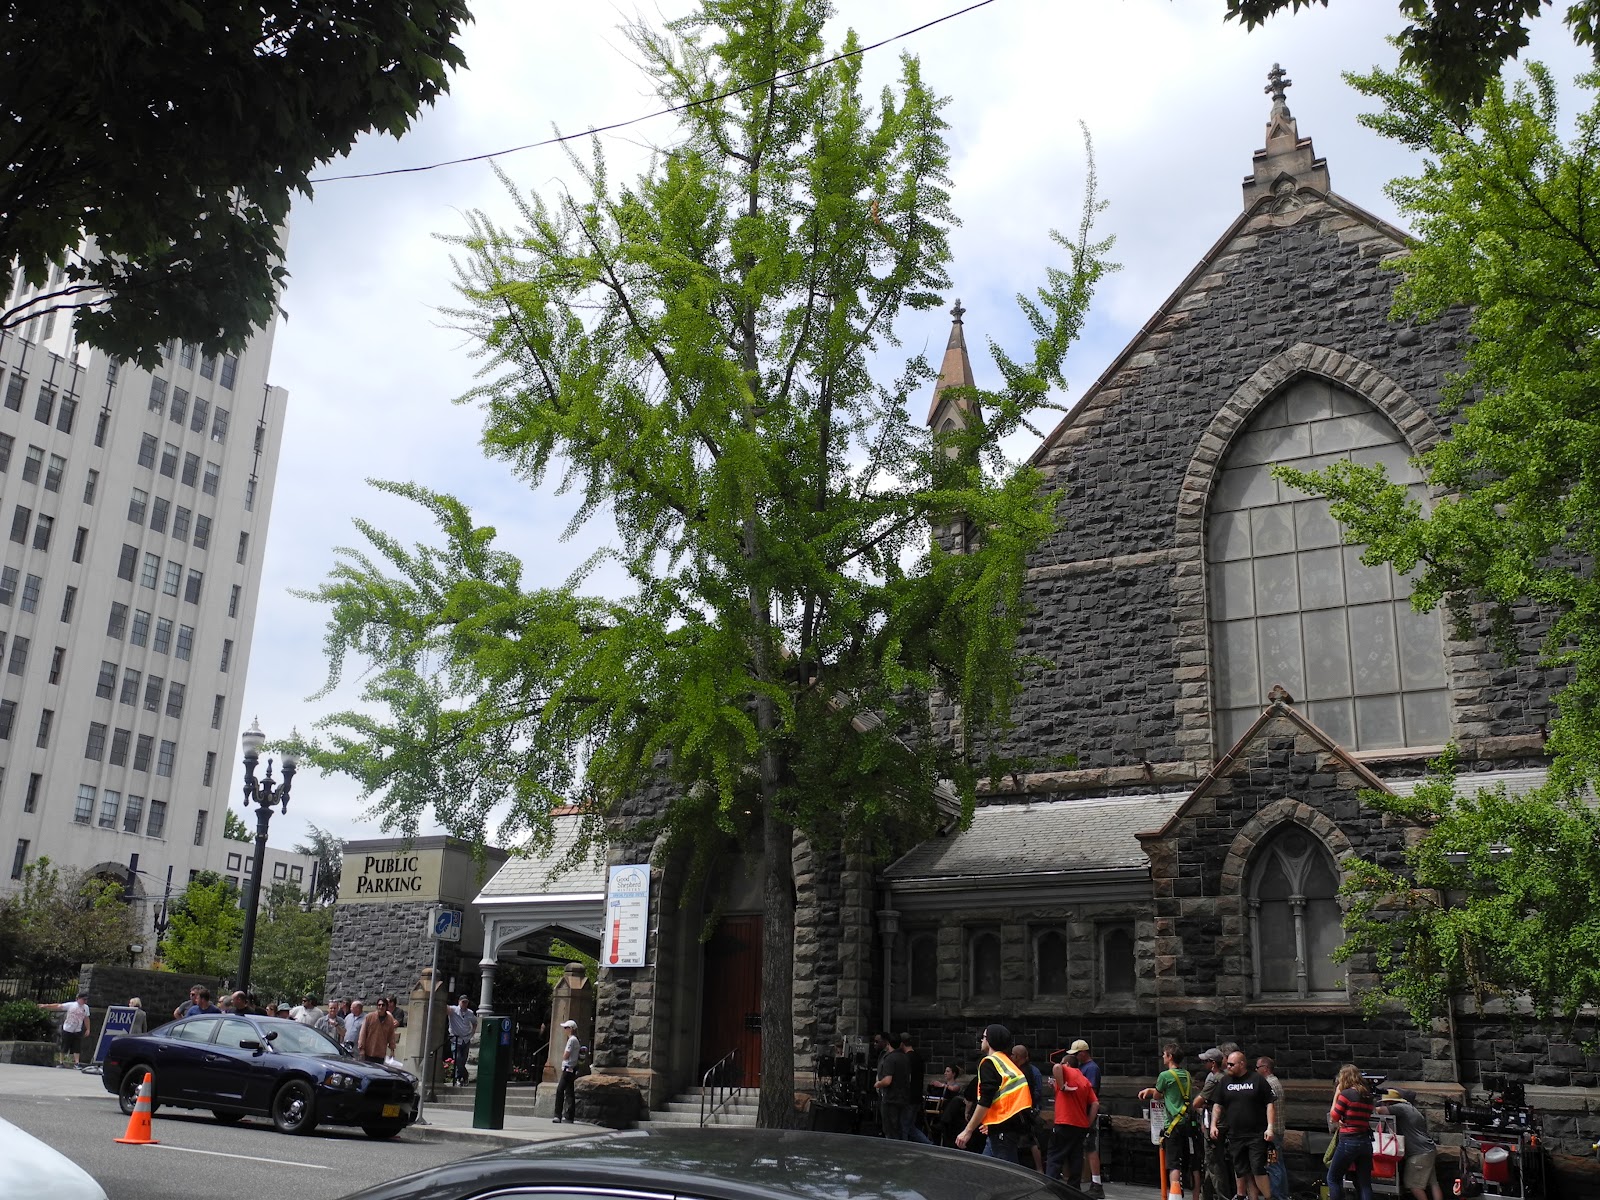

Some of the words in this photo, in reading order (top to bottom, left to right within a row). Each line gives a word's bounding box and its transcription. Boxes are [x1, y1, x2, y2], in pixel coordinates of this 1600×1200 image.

[364, 856, 419, 874] PUBLIC
[356, 876, 422, 894] PARKING
[107, 1011, 134, 1024] PARK
[1227, 1083, 1254, 1091] GRIMM
